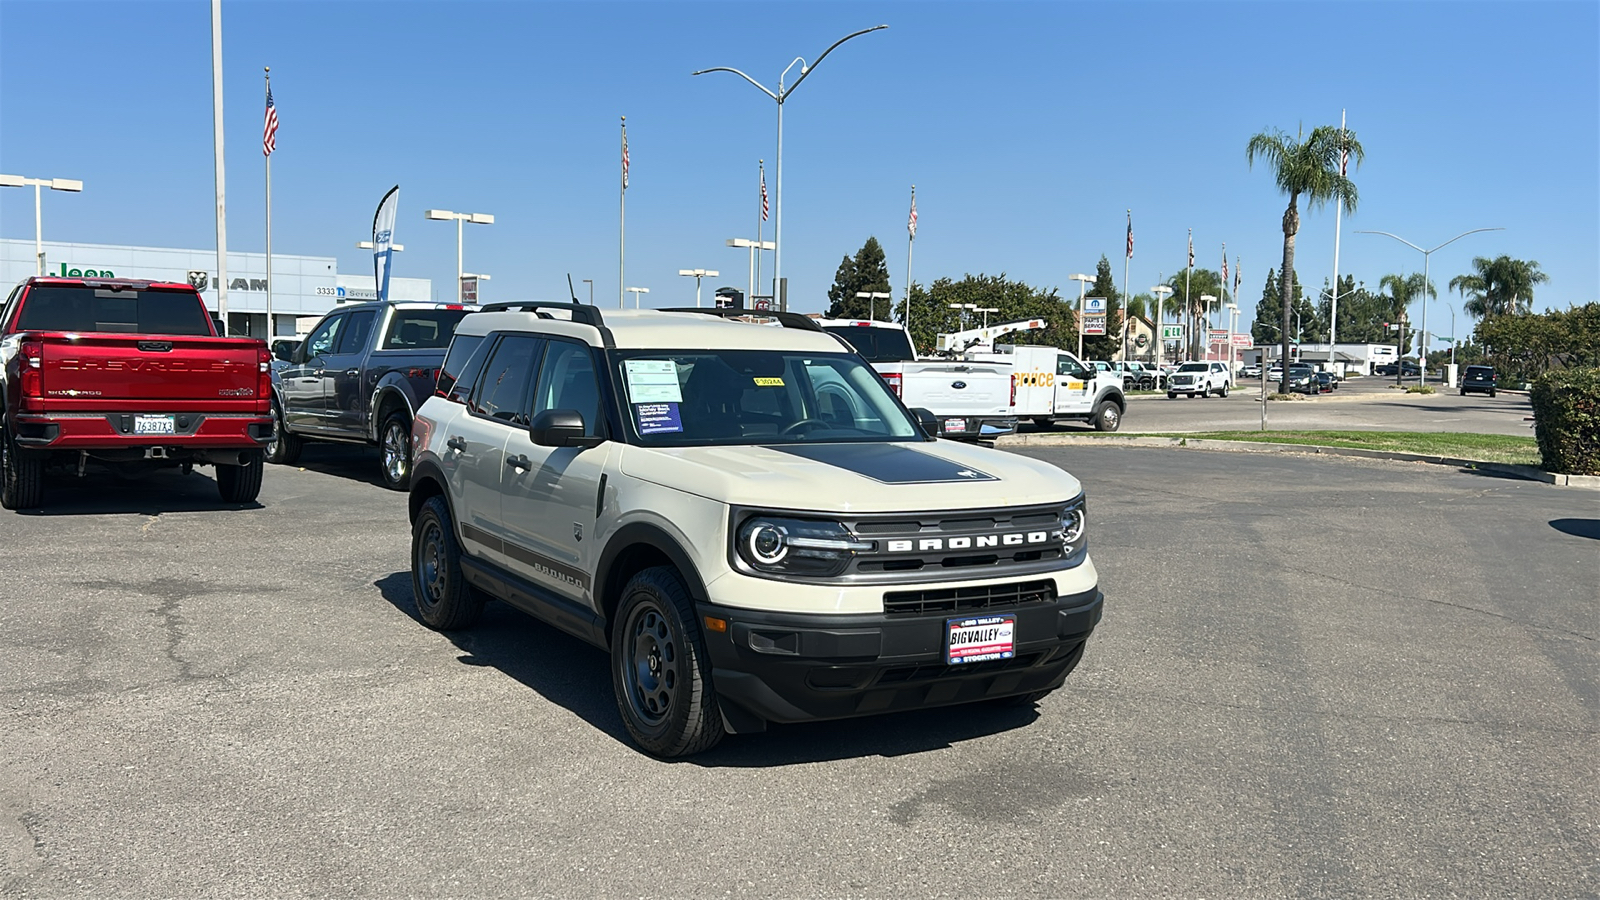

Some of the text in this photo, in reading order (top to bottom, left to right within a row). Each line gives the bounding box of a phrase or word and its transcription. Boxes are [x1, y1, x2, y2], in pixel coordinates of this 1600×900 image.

[316, 287, 335, 296] 3333
[349, 289, 377, 298] Servic
[59, 359, 245, 373] CHEVROLET
[1014, 367, 1054, 387] ervice
[137, 421, 172, 431] 76387X3
[887, 531, 1047, 552] BRONCO
[534, 562, 583, 588] BRONCO
[950, 628, 1000, 645] BIGVALLEY
[962, 653, 1001, 662] STOCKTON
